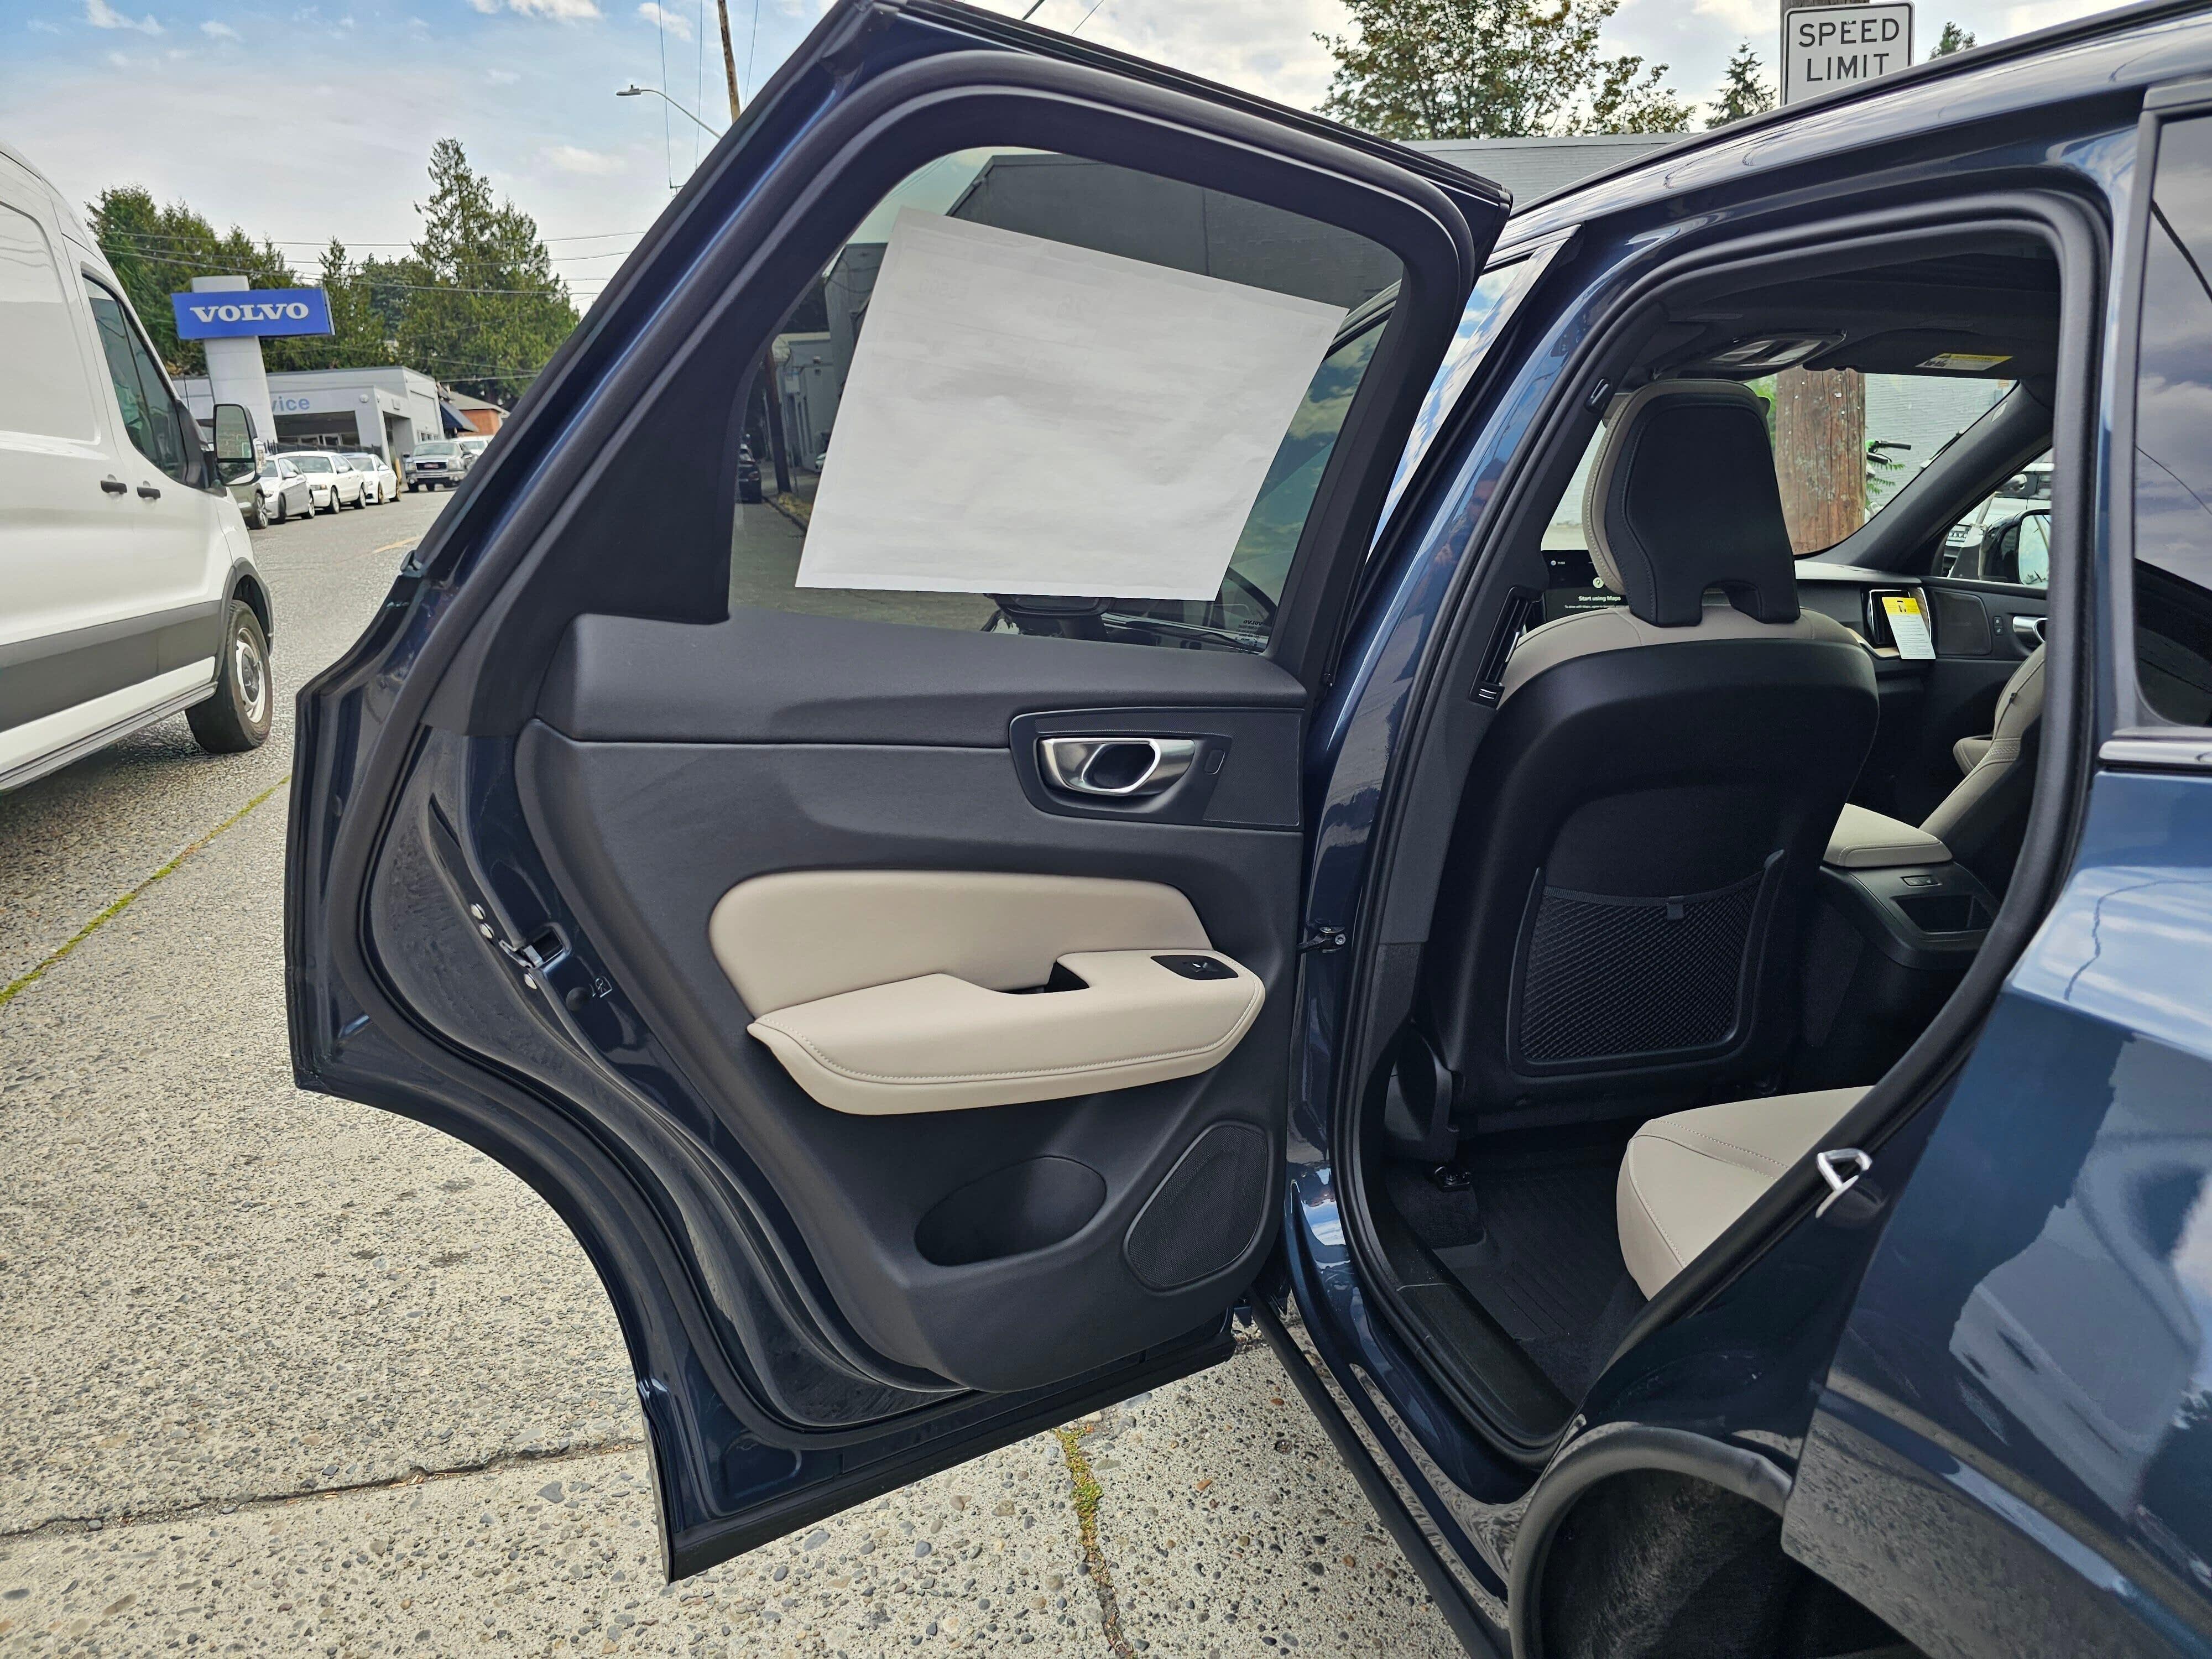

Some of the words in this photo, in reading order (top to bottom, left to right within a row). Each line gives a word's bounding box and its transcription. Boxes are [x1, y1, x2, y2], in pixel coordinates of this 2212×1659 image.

[1798, 18, 1900, 48] SPEED
[1807, 53, 1890, 82] LIMIT
[190, 302, 309, 322] VOLVO
